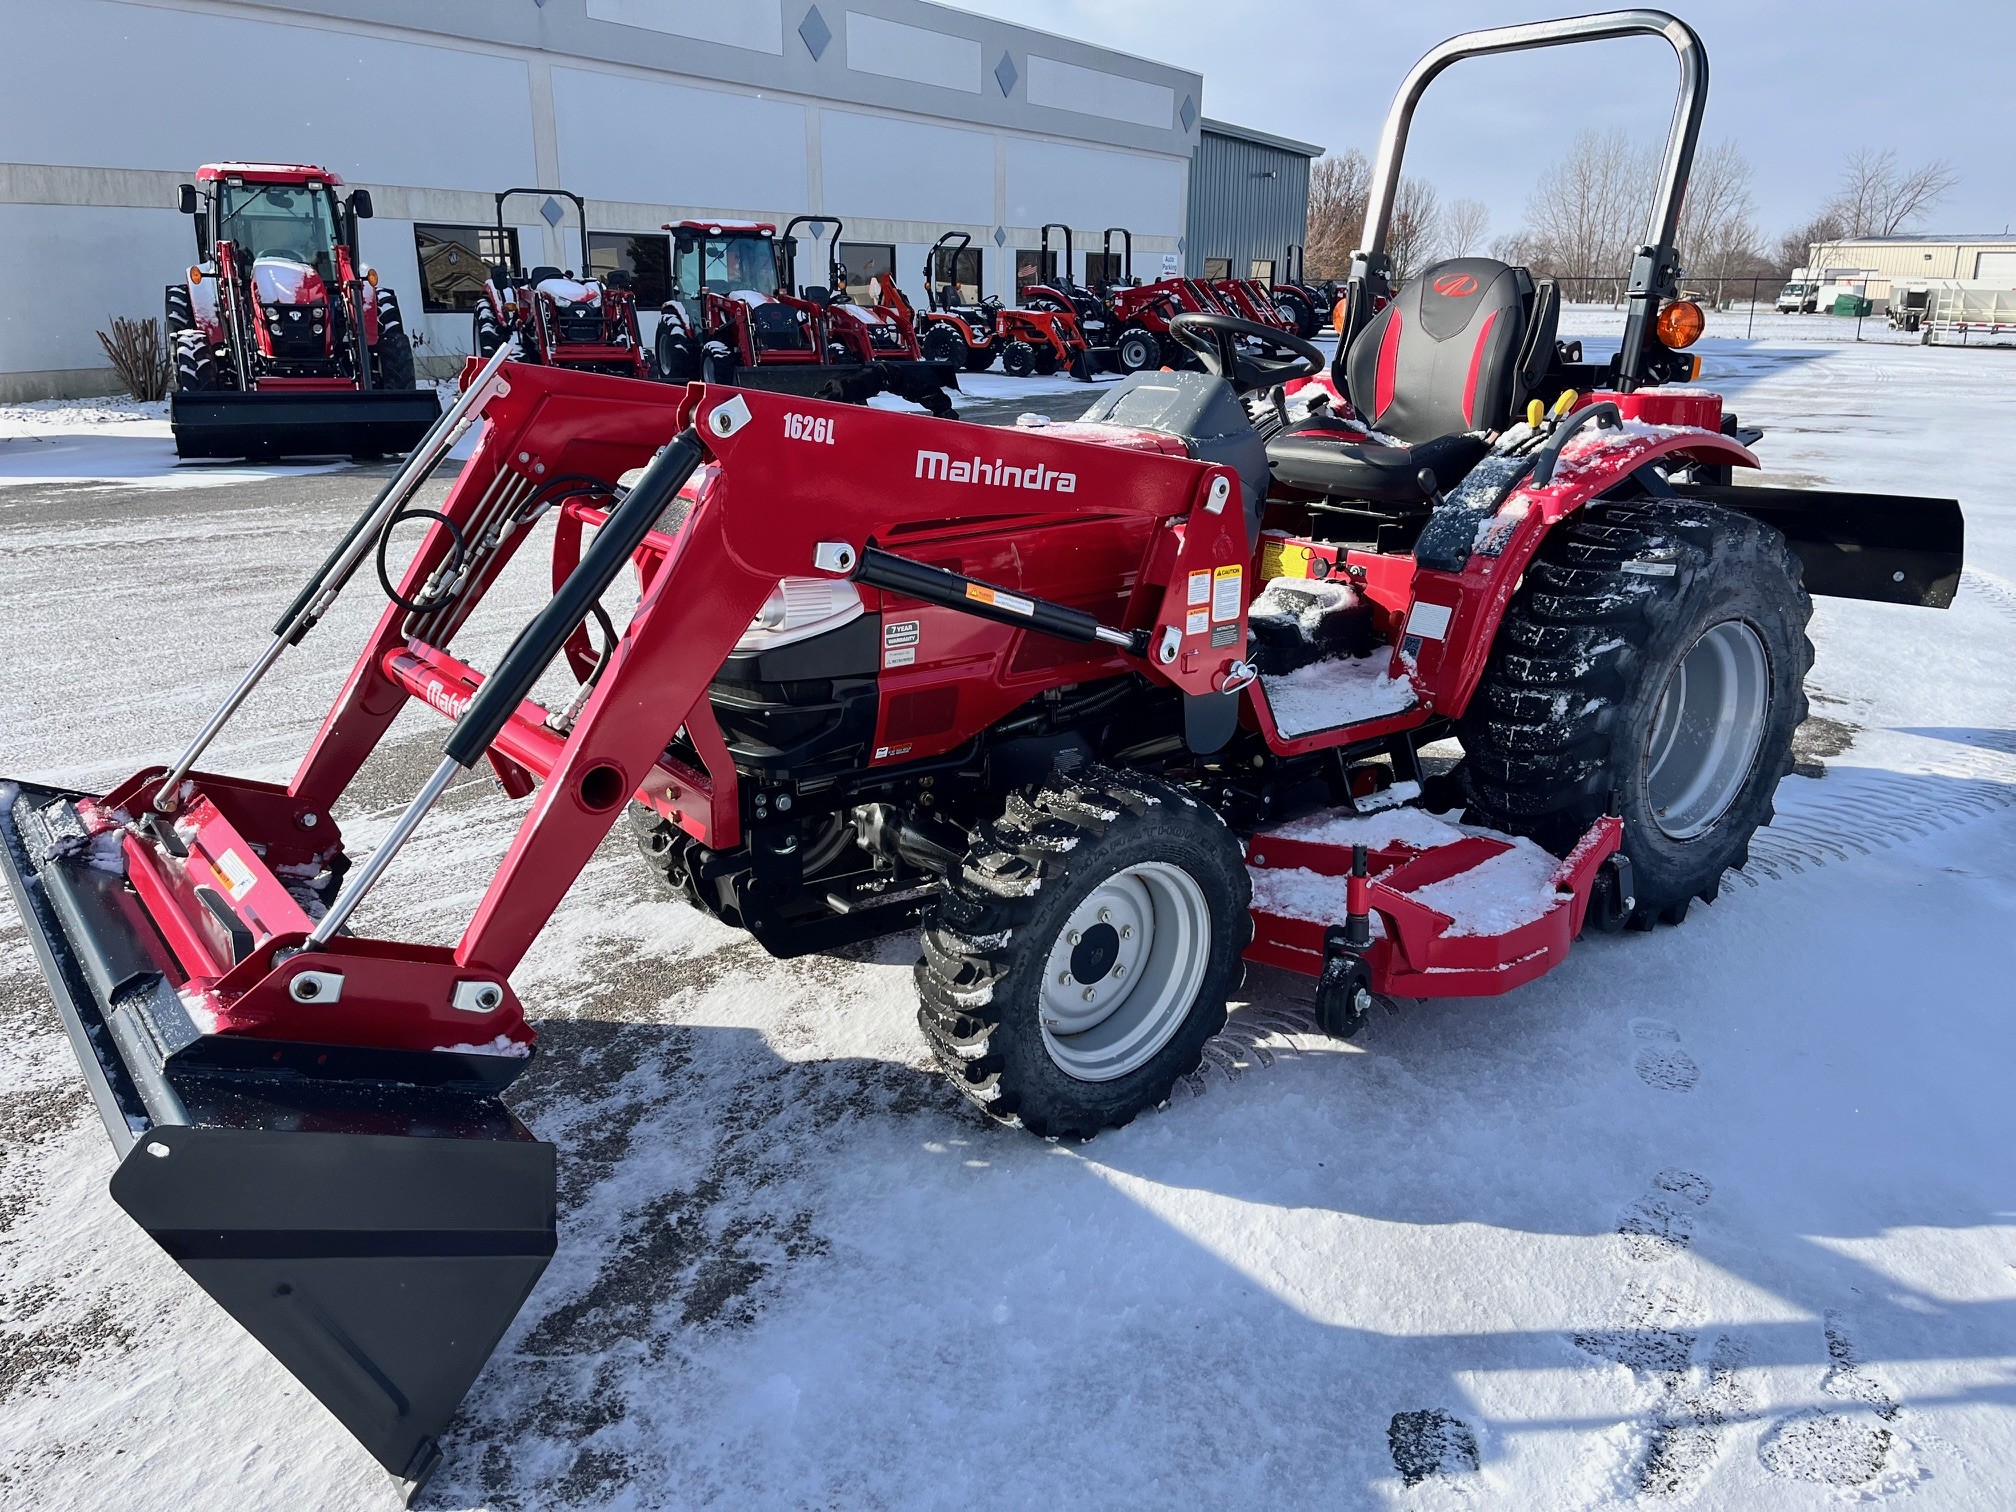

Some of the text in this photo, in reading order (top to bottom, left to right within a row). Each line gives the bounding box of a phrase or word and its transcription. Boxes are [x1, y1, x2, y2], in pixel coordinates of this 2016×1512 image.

[1162, 263, 1177, 272] Parking
[783, 412, 835, 445] 1626L
[915, 449, 1077, 493] Mahindra
[1221, 568, 1240, 576] CAUTION
[891, 624, 913, 634] 7 YEAR
[888, 635, 916, 645] WARRANTY
[1034, 877, 1073, 927] THE
